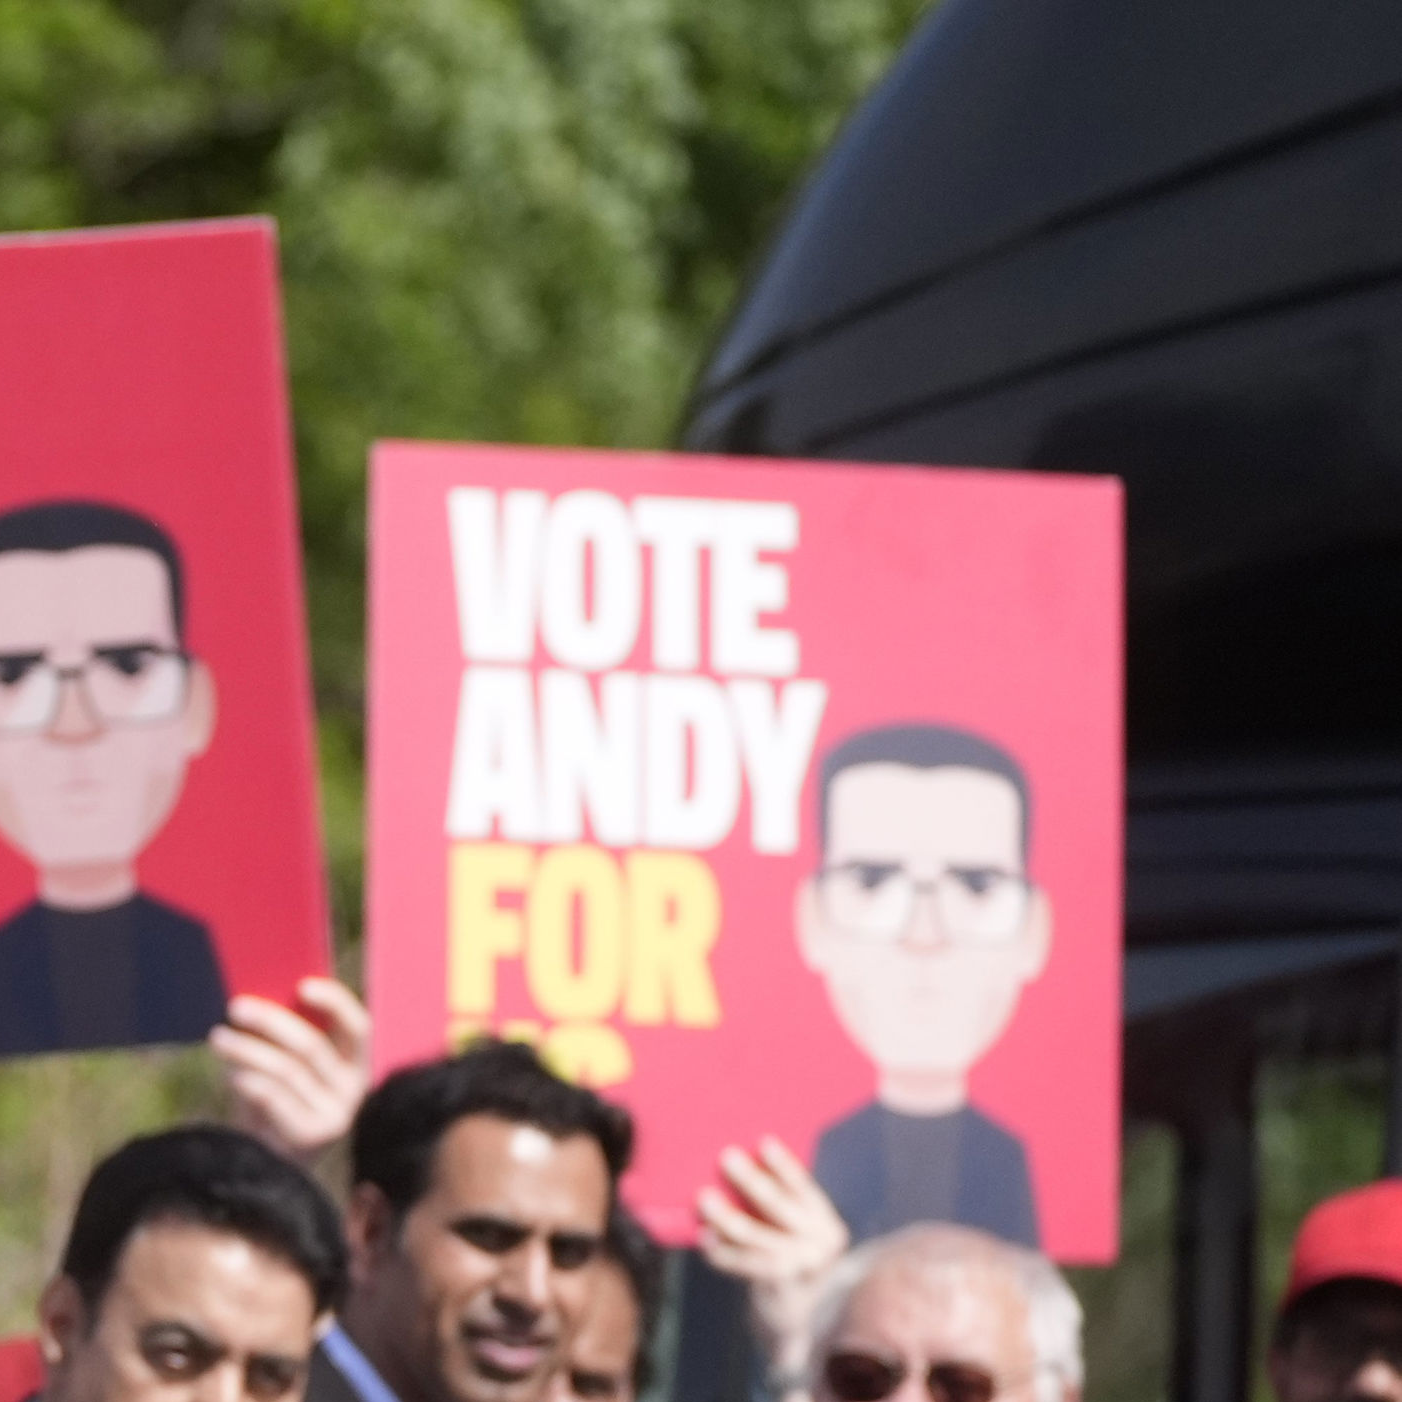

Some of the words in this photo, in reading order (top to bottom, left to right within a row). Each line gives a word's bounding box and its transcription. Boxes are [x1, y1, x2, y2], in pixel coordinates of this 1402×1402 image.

[446, 485, 801, 677] VOTE
[444, 666, 828, 856] ANDY
[446, 842, 723, 1029] FOR
